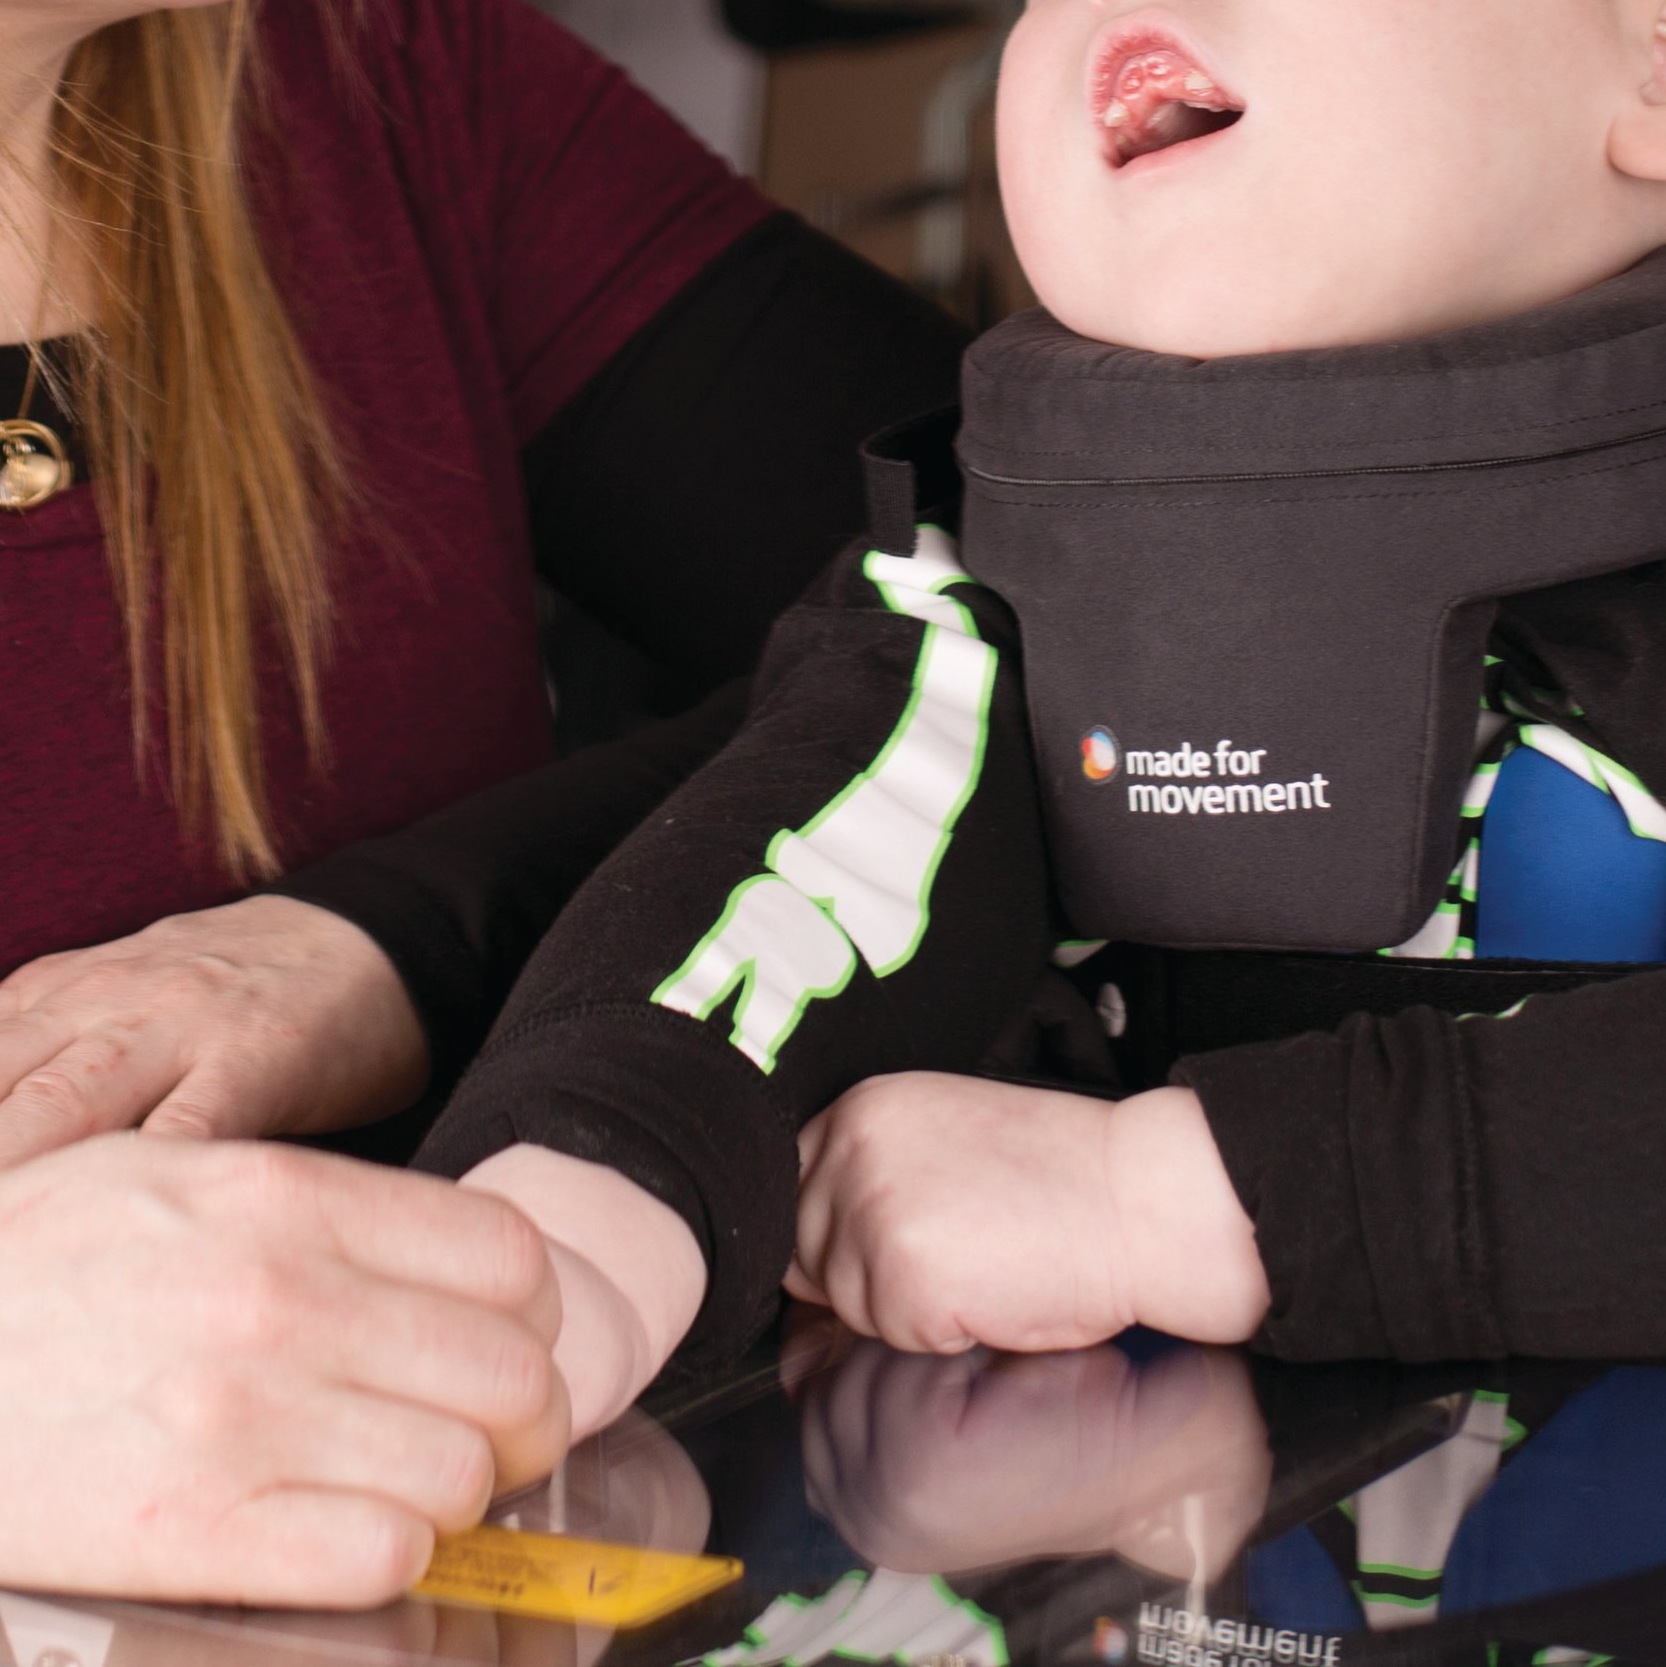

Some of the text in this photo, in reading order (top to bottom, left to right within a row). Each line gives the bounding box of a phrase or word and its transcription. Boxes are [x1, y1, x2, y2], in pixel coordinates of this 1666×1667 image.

[1126, 739, 1267, 777] made for
[1128, 773, 1331, 814] movement
